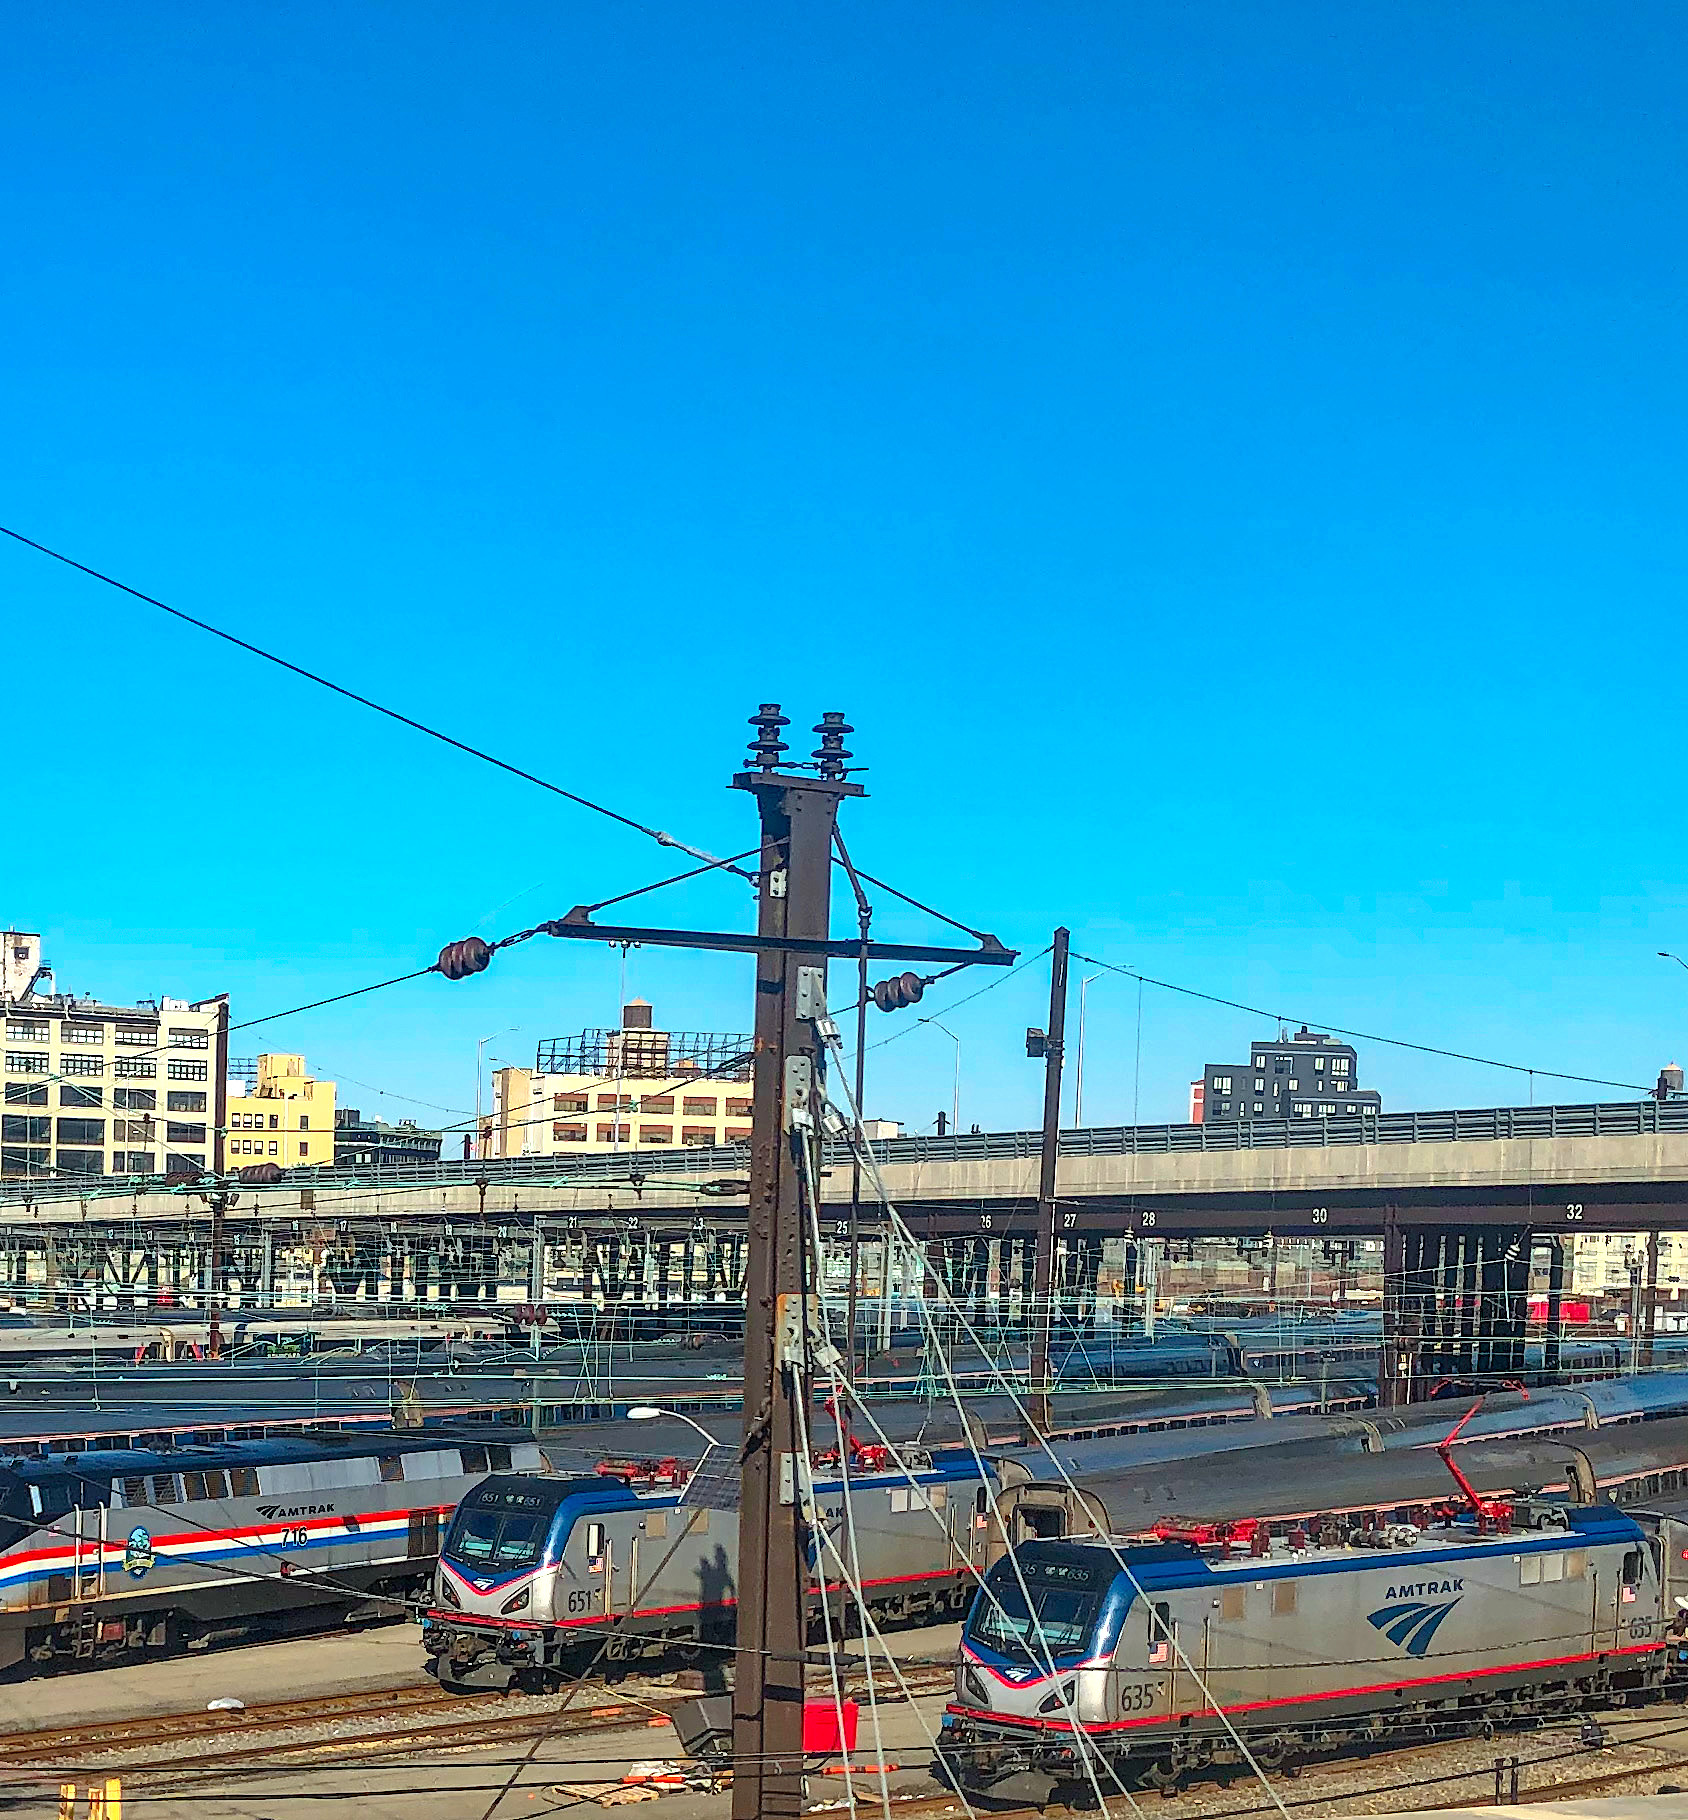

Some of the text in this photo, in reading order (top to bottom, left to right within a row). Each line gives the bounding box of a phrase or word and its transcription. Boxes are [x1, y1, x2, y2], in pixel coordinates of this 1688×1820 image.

[1312, 1207, 1327, 1224] 30
[1566, 1203, 1583, 1220] 32
[568, 1216, 578, 1228] 21
[628, 1216, 639, 1229] 22
[981, 1215, 992, 1229] 26
[1063, 1213, 1077, 1228] 27
[1142, 1212, 1156, 1227] 28
[836, 1221, 848, 1235] 25
[481, 1491, 499, 1503] 651
[277, 1503, 335, 1518] AMTRAK
[280, 1526, 308, 1549] 716
[1067, 1568, 1090, 1581] 635
[1384, 1578, 1464, 1600] AMTRAK
[568, 1590, 592, 1613] 651
[1121, 1683, 1154, 1712] 635
